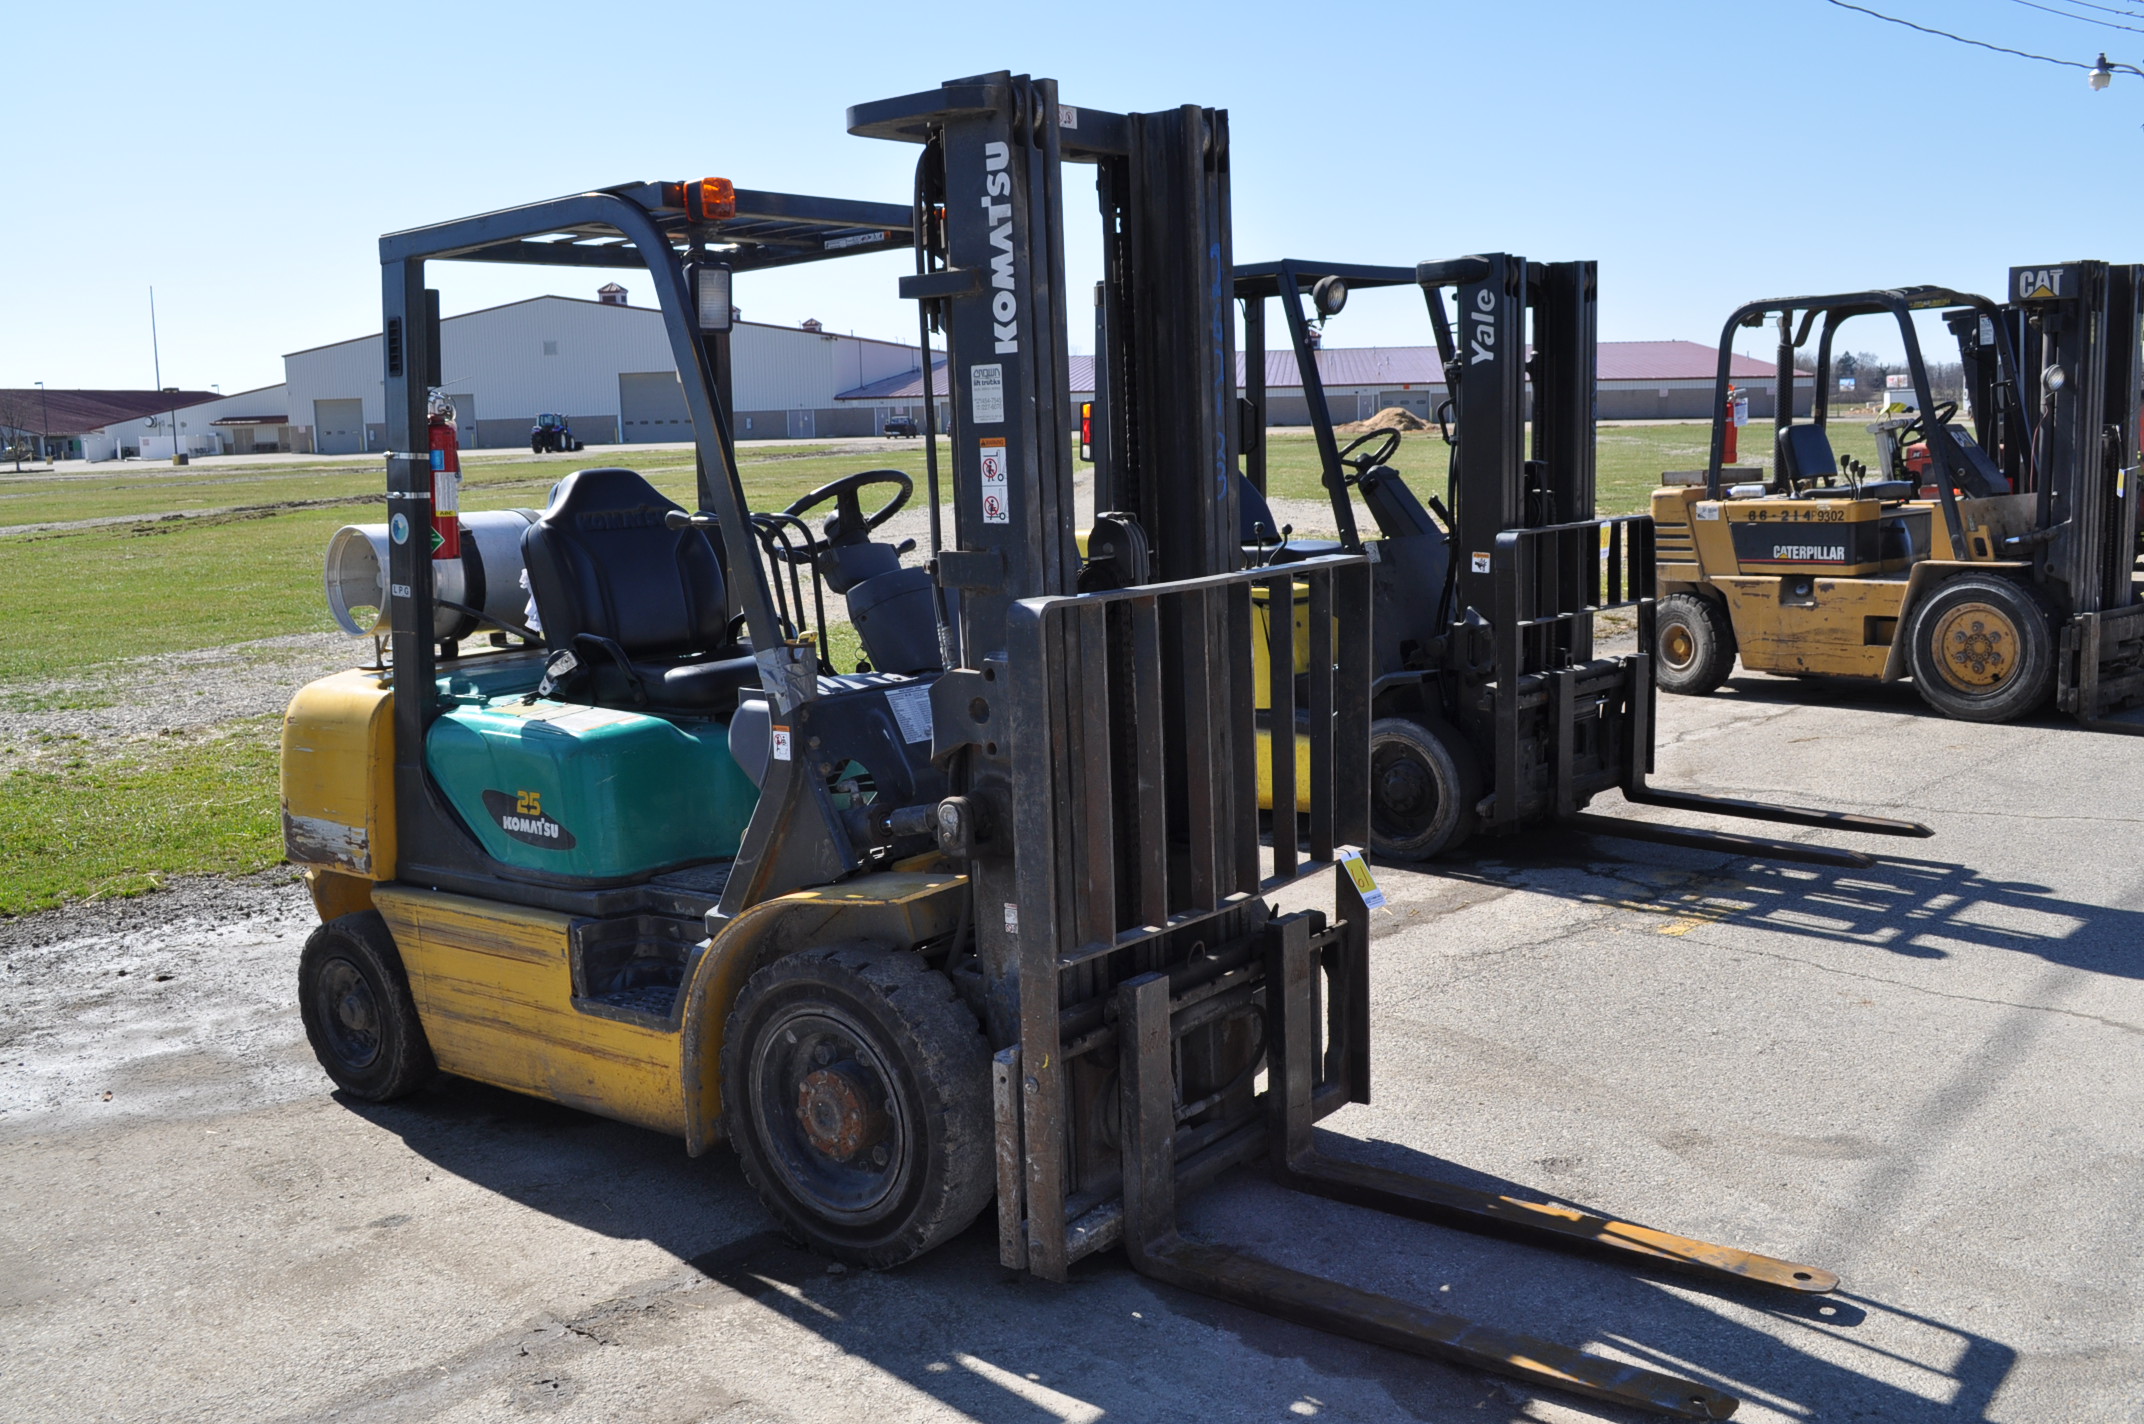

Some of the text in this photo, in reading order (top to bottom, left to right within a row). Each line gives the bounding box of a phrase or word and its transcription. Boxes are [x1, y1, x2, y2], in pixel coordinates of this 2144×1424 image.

[981, 141, 1018, 354] KOMATSU
[2019, 269, 2064, 298] CAT
[1471, 289, 1496, 365] Yale
[1773, 545, 1845, 560] CATERPILLAR
[393, 585, 410, 596] LPG
[516, 790, 541, 816] 25
[502, 815, 559, 839] KOMATSU
[1351, 866, 1370, 888] 61
